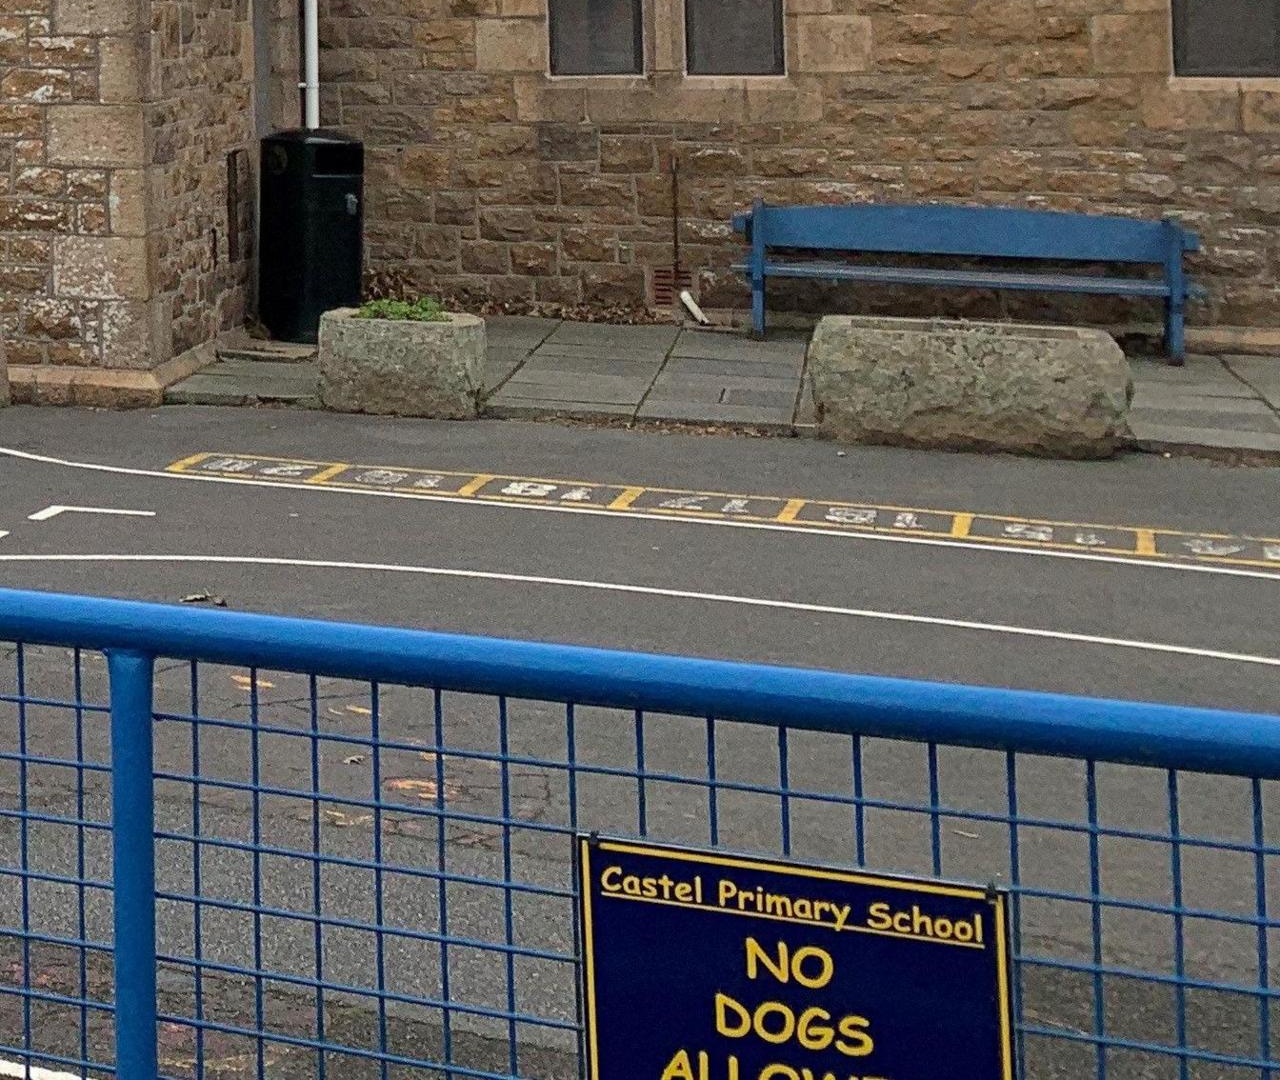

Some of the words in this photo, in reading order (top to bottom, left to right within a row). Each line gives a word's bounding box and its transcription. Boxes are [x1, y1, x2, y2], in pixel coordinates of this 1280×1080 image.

[600, 866, 703, 904] Castel
[718, 878, 851, 931] Primary
[867, 902, 983, 943] School
[745, 937, 834, 989] NO
[714, 992, 875, 1057] DOGS
